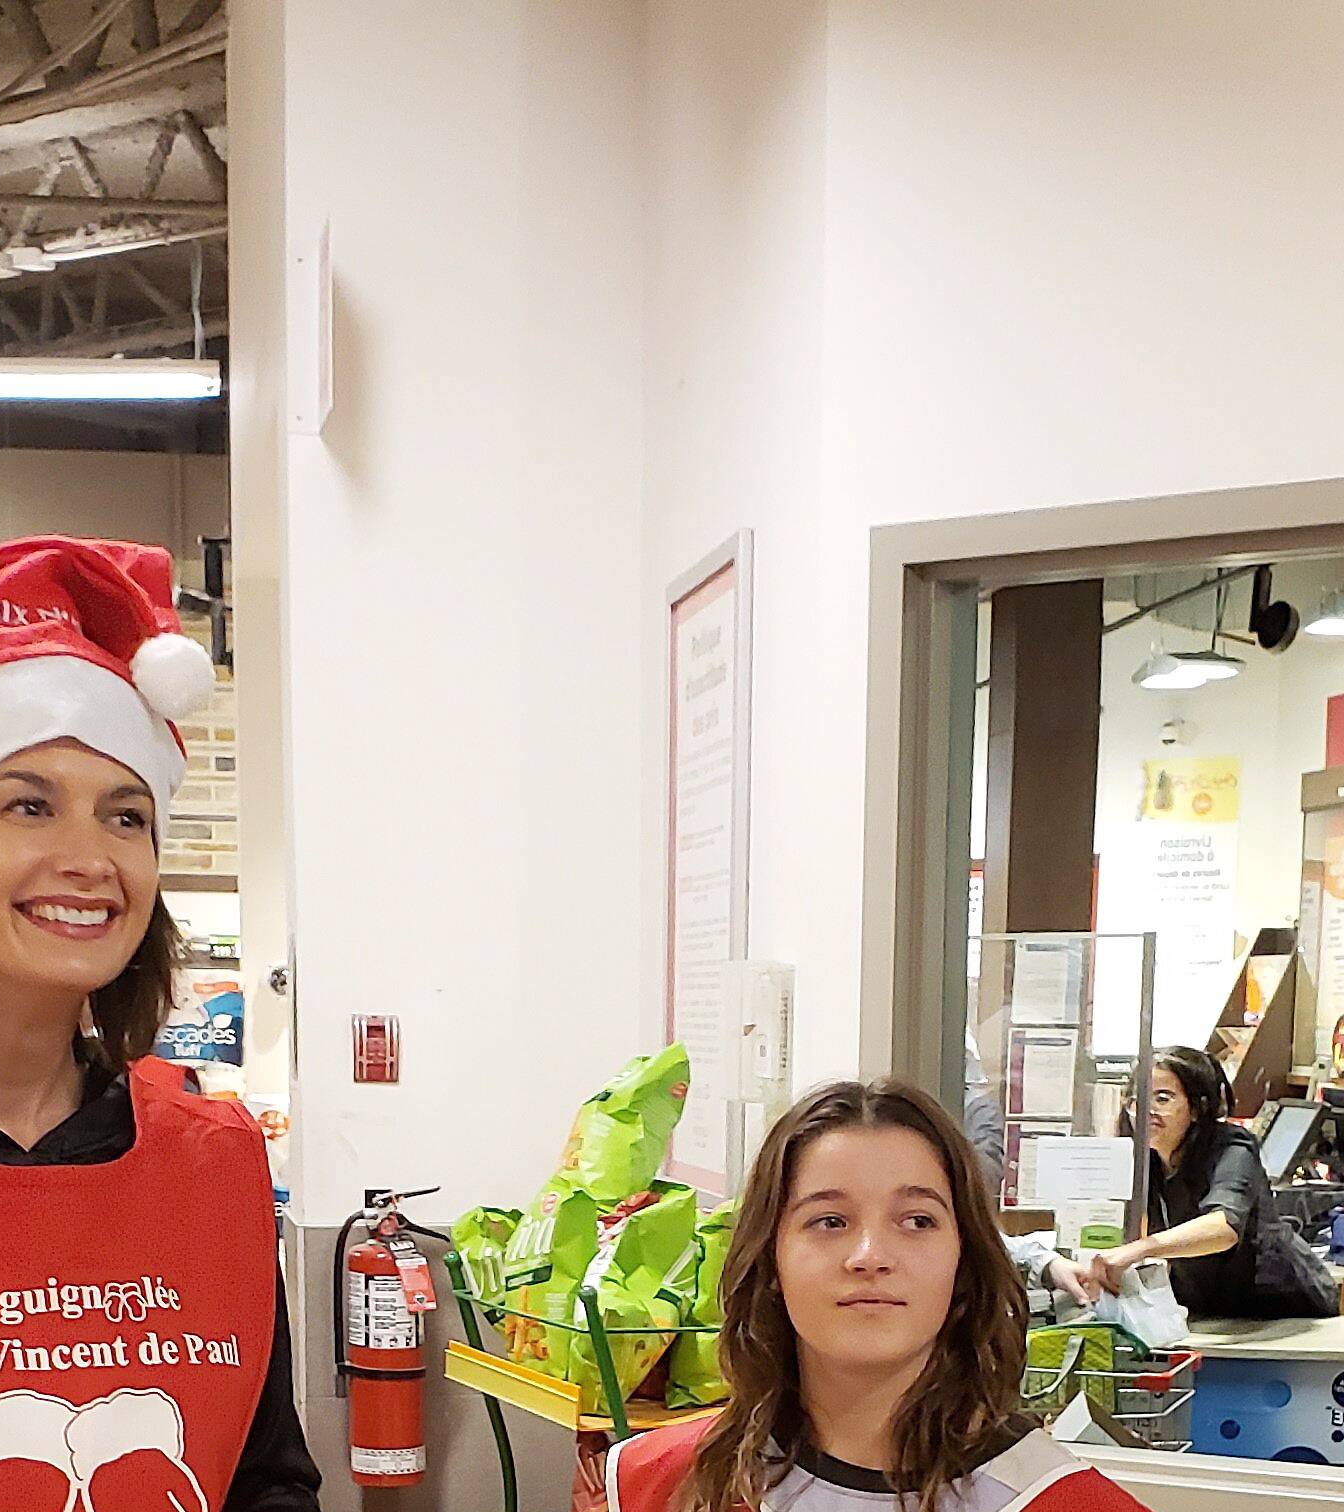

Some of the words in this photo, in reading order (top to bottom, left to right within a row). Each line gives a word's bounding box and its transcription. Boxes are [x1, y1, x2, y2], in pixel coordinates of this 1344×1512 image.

[155, 1024, 237, 1045] scades
[138, 1331, 180, 1365] de
[183, 1333, 241, 1368] Paul
